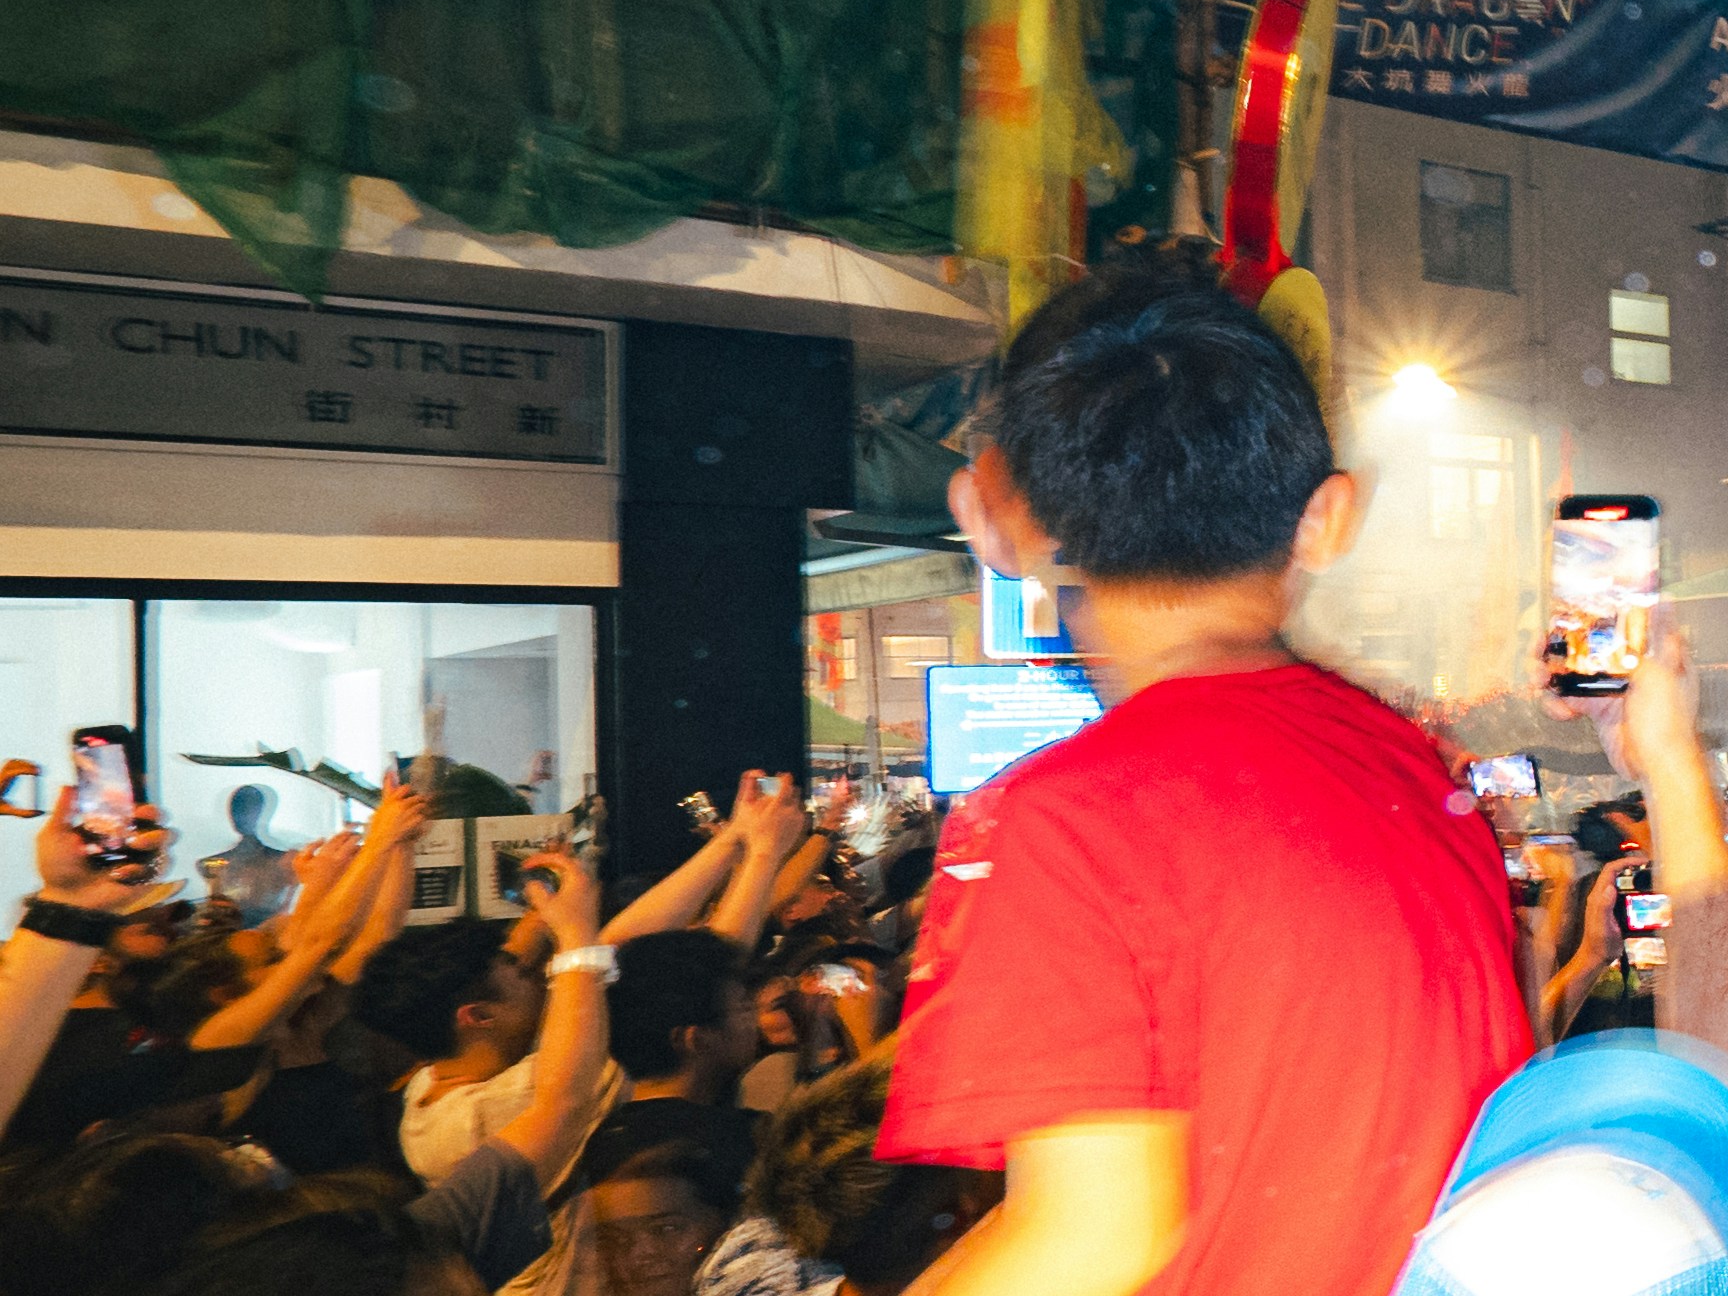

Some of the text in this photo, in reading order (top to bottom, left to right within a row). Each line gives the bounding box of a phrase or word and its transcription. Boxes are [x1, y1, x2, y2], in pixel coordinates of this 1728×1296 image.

[1360, 17, 1520, 64] DANCE
[1344, 68, 1530, 98] 大坑舞火龍
[111, 315, 299, 365] CHUN
[346, 335, 558, 383] STREET
